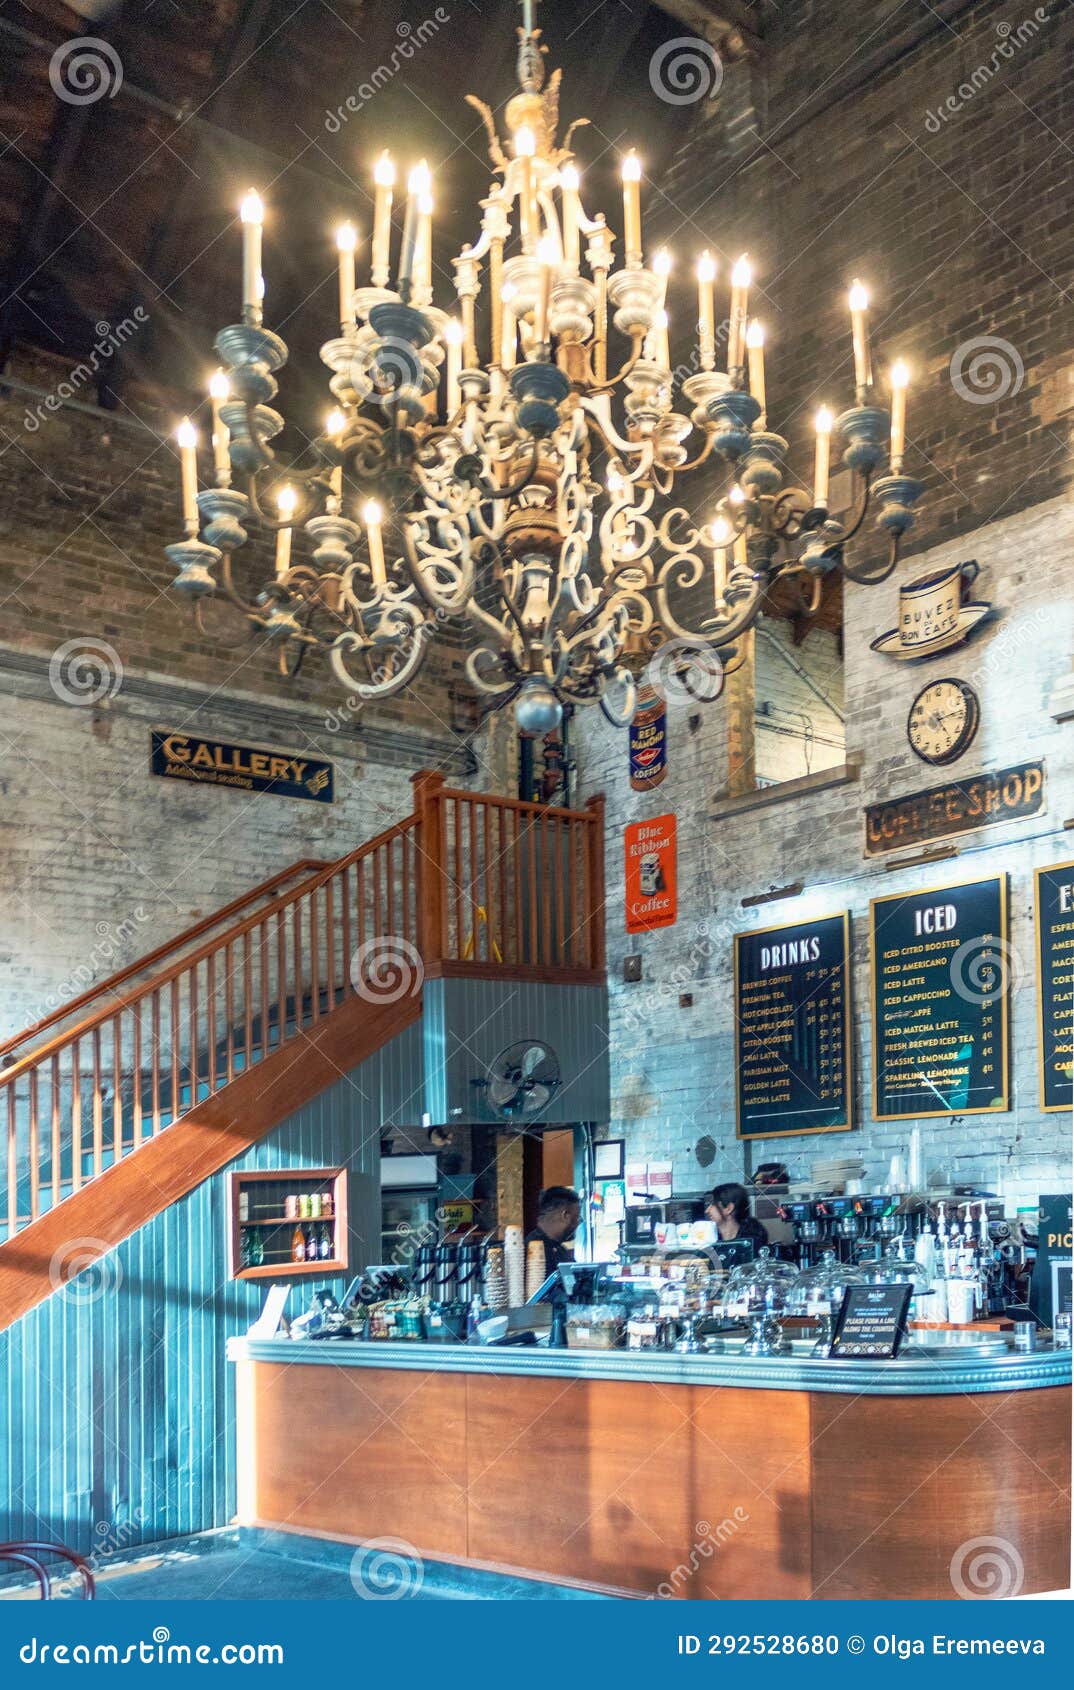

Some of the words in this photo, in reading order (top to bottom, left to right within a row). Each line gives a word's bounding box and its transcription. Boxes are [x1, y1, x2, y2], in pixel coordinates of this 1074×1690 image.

[903, 598, 953, 624] BUVEZ
[900, 630, 919, 640] BON
[631, 731, 664, 750] DIAMOND
[638, 726, 657, 739] RED
[163, 736, 308, 783] GALLERY
[634, 762, 662, 779] COFFEE
[967, 768, 1043, 816] SHOP
[637, 825, 664, 841] Blue
[630, 838, 670, 857] Ribbon
[632, 897, 671, 915] Coffee
[1059, 884, 1073, 913] E
[915, 904, 957, 936] ICED
[761, 936, 820, 970] DRINKS
[884, 949, 900, 959] ICED
[925, 939, 961, 952] BOOSTER
[884, 964, 900, 974] ICED
[902, 957, 948, 971] AMERICANO
[884, 980, 901, 989] ICED
[902, 976, 926, 987] LATTE
[772, 991, 785, 999] TEA
[884, 996, 902, 1006] ICED
[903, 989, 951, 1003] CAPPUCCINO
[885, 1027, 902, 1036] ICED
[904, 1023, 934, 1034] MATCHA
[935, 1020, 960, 1030] LATTE
[884, 1042, 907, 1052] FRESH
[909, 1038, 938, 1049] BREWED
[940, 1036, 957, 1045] ICED
[959, 1034, 974, 1043] TEA
[884, 1057, 915, 1067] CLASSIC
[917, 1051, 959, 1063] LEMONADE
[927, 1066, 969, 1077] LEMONADE
[770, 1079, 790, 1088] LATTE
[771, 1094, 790, 1102] LATTE
[846, 1317, 864, 1325] PLEASE
